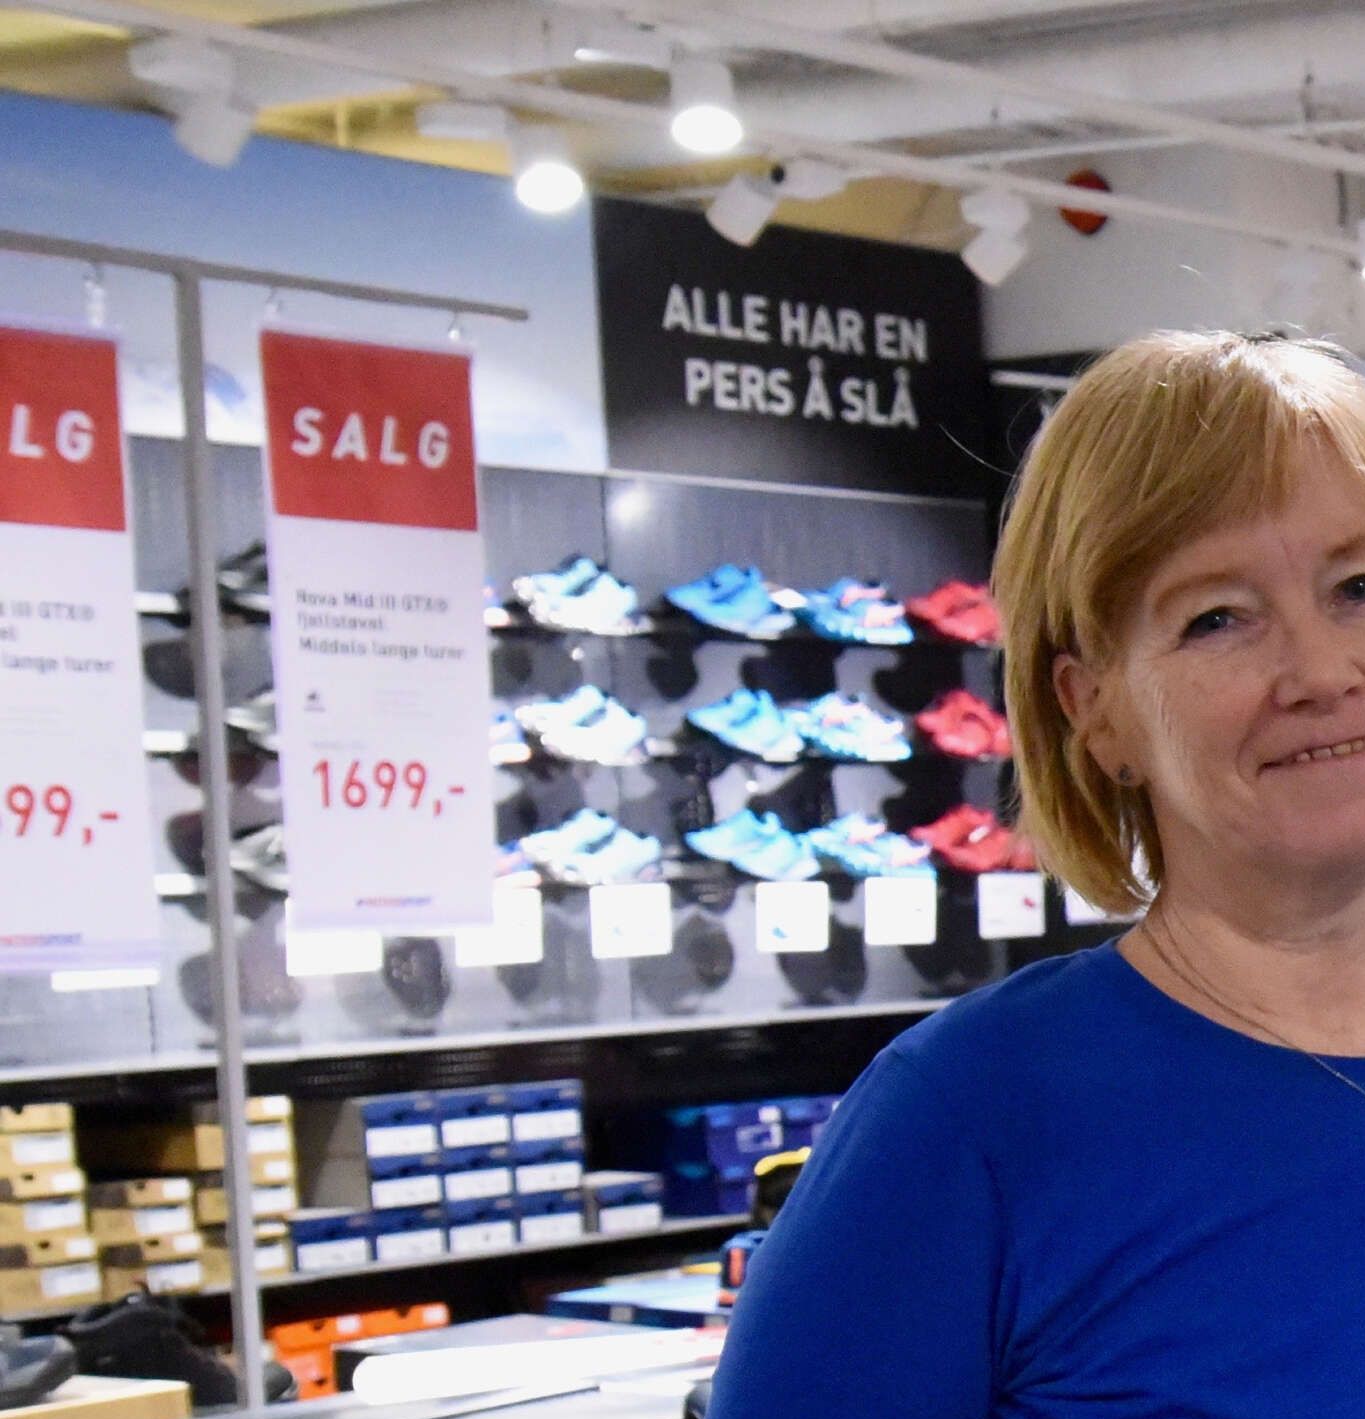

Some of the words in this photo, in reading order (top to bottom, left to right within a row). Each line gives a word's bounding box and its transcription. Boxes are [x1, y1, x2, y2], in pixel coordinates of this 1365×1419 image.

[662, 283, 770, 344] ALLE
[779, 299, 866, 356] HAR
[874, 311, 929, 363] EN
[685, 357, 796, 417] PERS
[802, 355, 833, 421] Å
[839, 365, 919, 430] SLÅ
[291, 406, 450, 470] SALG
[312, 759, 465, 817] 1699,-
